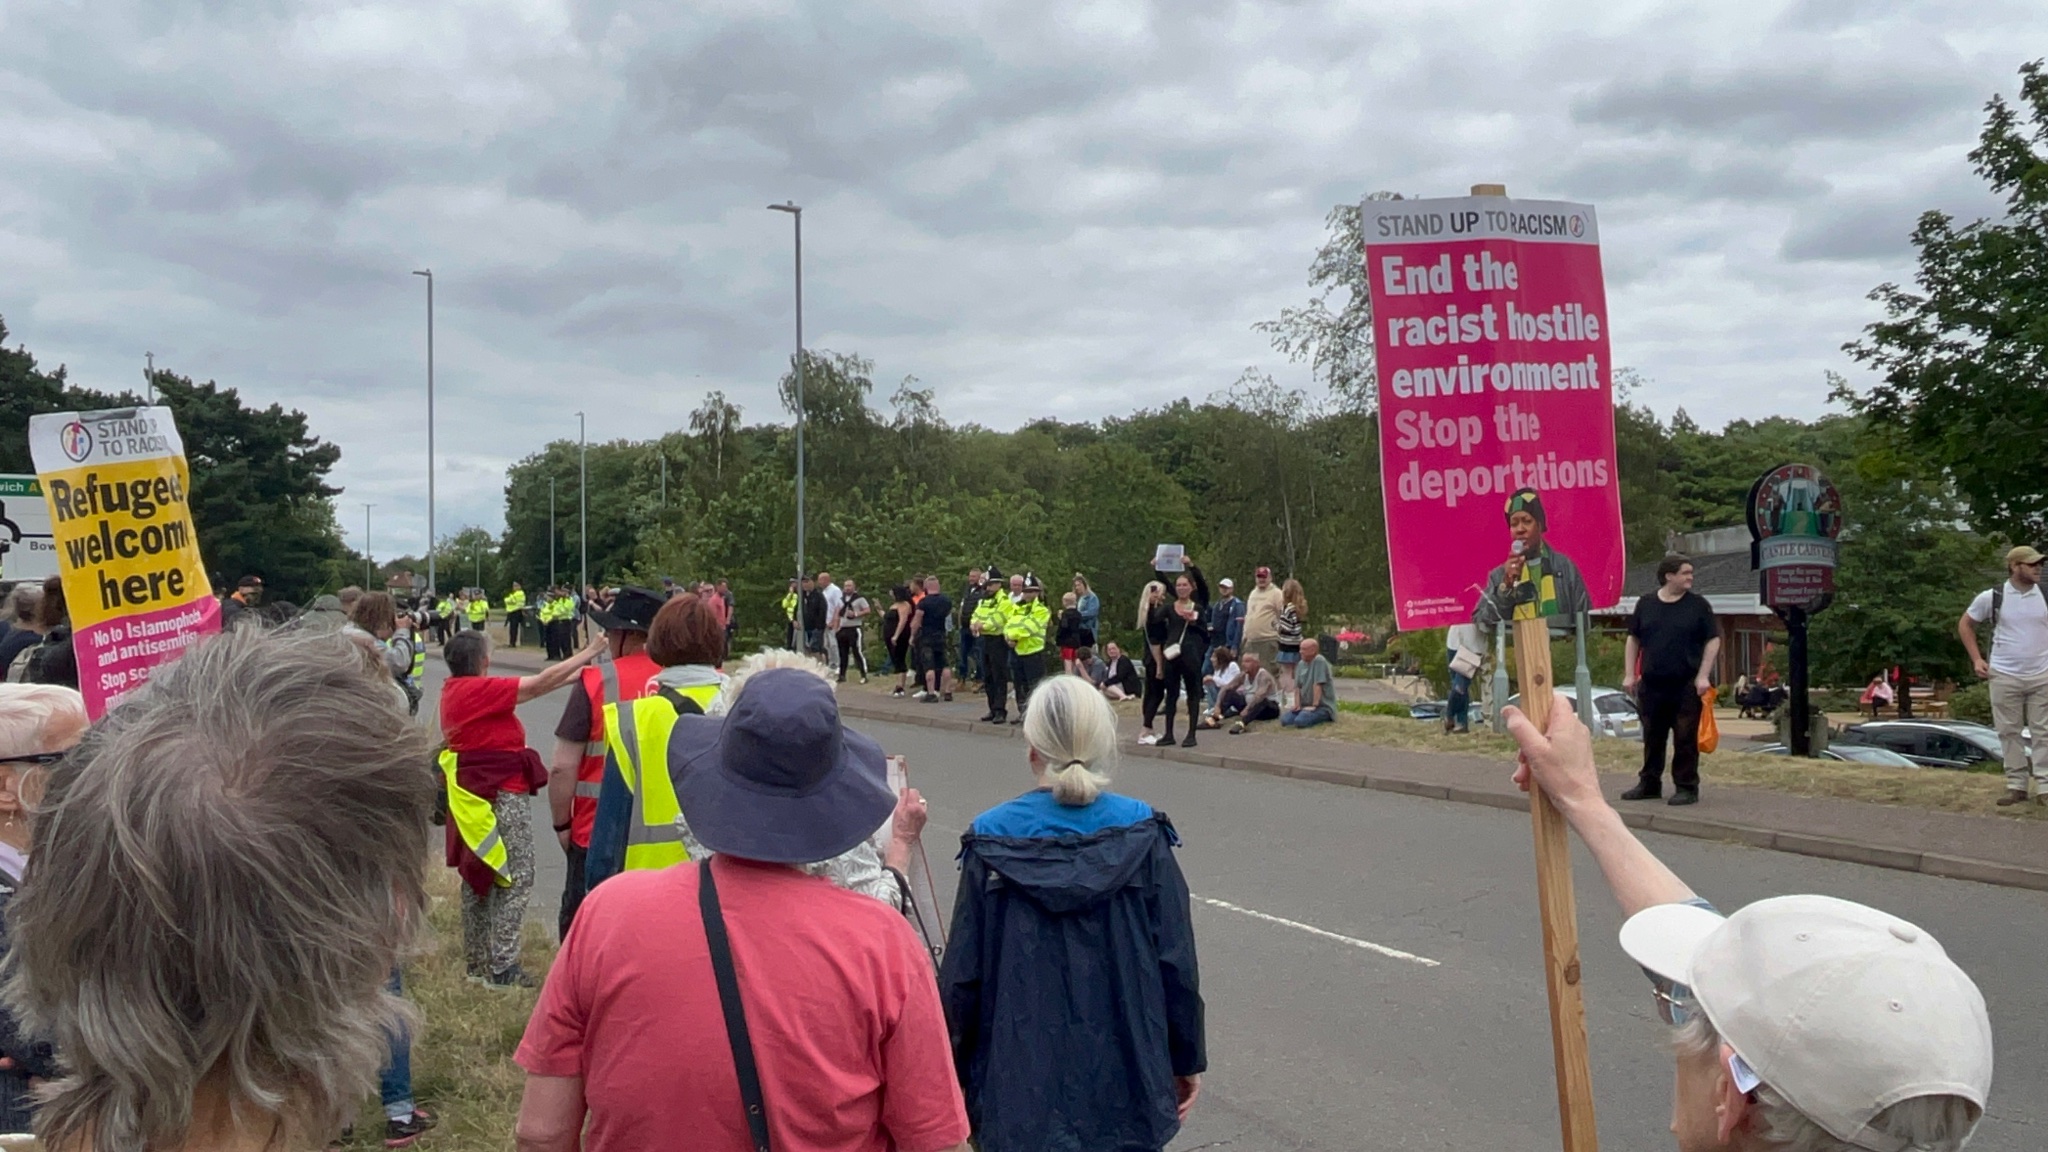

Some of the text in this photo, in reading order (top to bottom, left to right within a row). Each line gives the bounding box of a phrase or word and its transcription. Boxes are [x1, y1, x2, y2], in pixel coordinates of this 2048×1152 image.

[1377, 210, 1567, 237] STAND UP TO RACISM
[1381, 251, 1519, 296] End the
[1388, 301, 1600, 347] racist hostile
[1391, 354, 1600, 398] environment
[97, 419, 148, 438] STAND
[1395, 402, 1540, 455] Stop the
[99, 439, 123, 456] TO
[1398, 452, 1608, 507] deportations
[49, 473, 184, 522] Refugee
[30, 541, 56, 551] Bow
[65, 520, 190, 570] welcom
[1761, 543, 1797, 560] CASTLE
[98, 568, 184, 610] here
[93, 629, 109, 648] No
[110, 627, 123, 642] to
[98, 645, 118, 667] and
[101, 671, 126, 690] Stop
